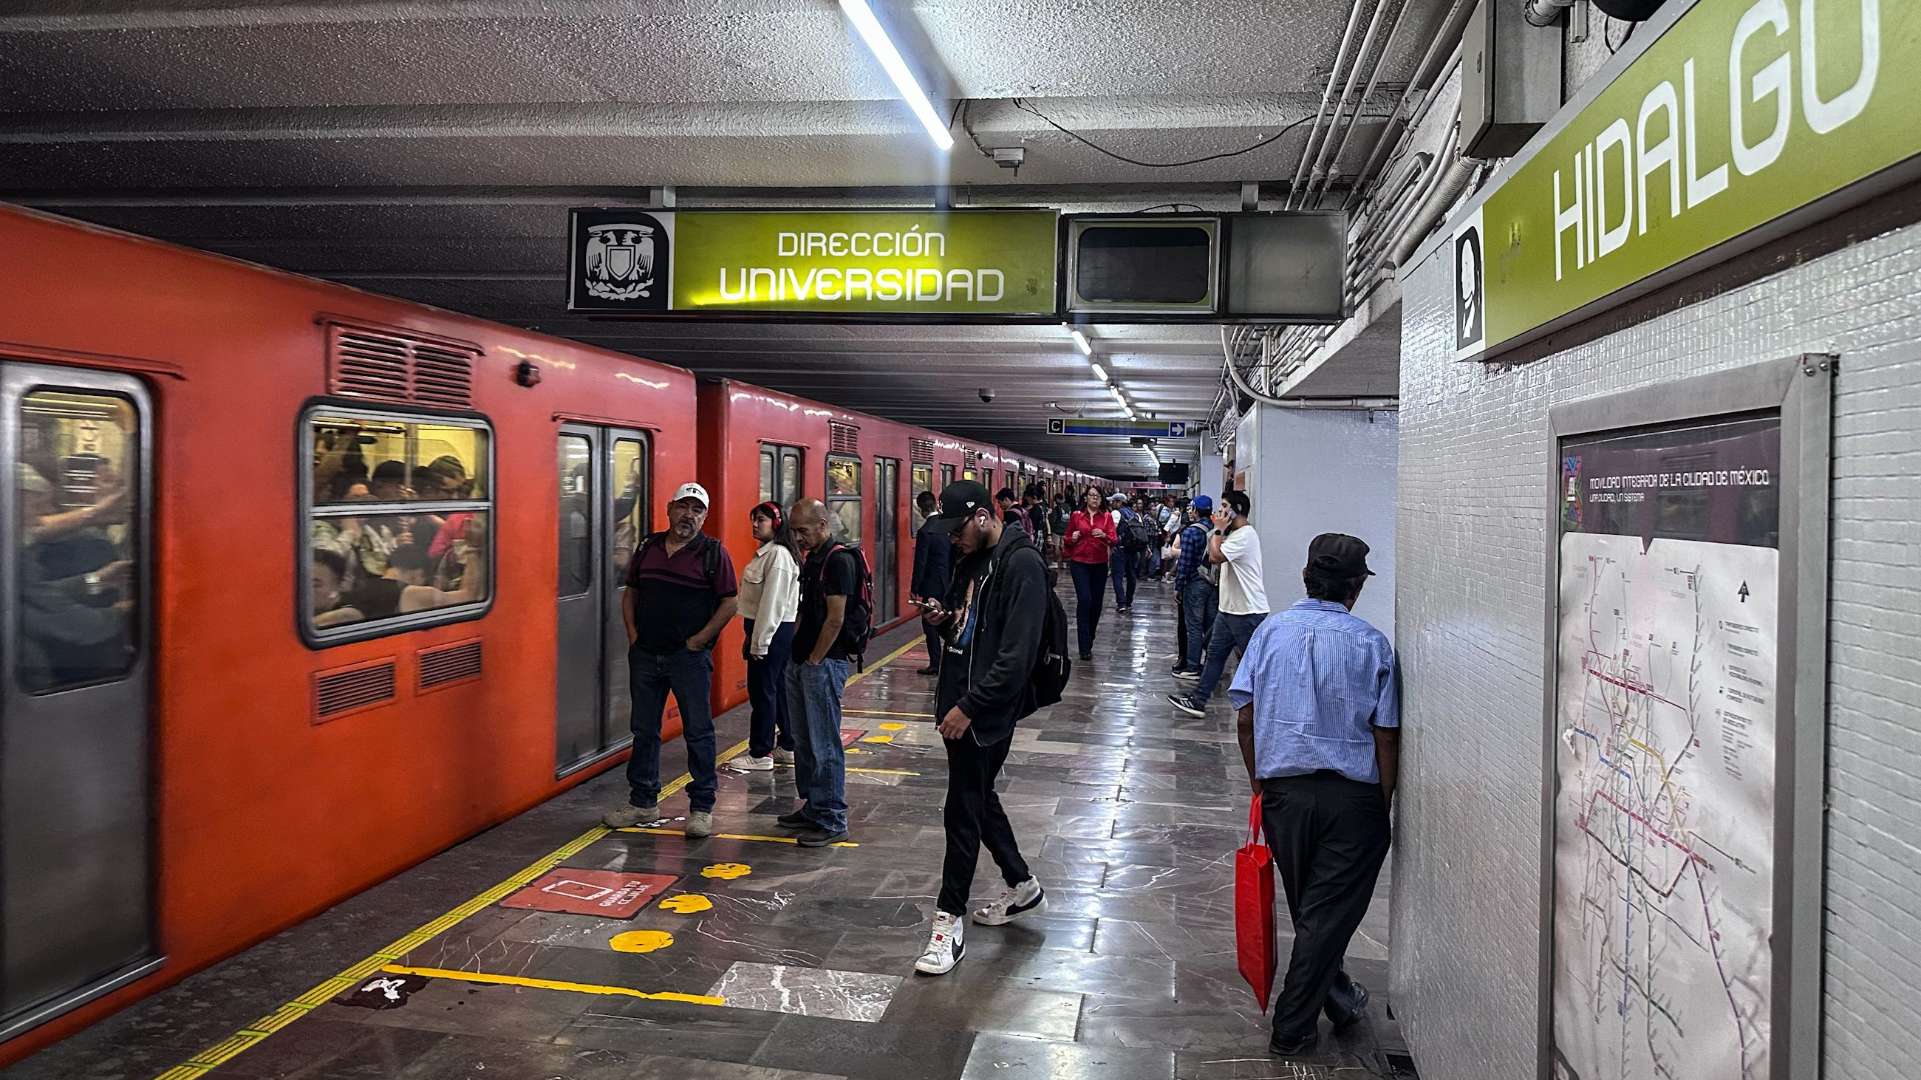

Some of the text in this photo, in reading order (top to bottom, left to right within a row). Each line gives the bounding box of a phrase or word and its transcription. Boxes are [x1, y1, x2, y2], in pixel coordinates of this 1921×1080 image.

[778, 224, 945, 257] DIRECCIÓN
[720, 267, 1005, 301] UNIVERSIDAD
[1051, 420, 1061, 432] C
[1622, 474, 1658, 489] INTEGRADA
[1671, 472, 1682, 487] LA
[1683, 471, 1714, 486] CIUDAD
[1716, 471, 1728, 486] DE
[1730, 465, 1769, 485] MÉXICO
